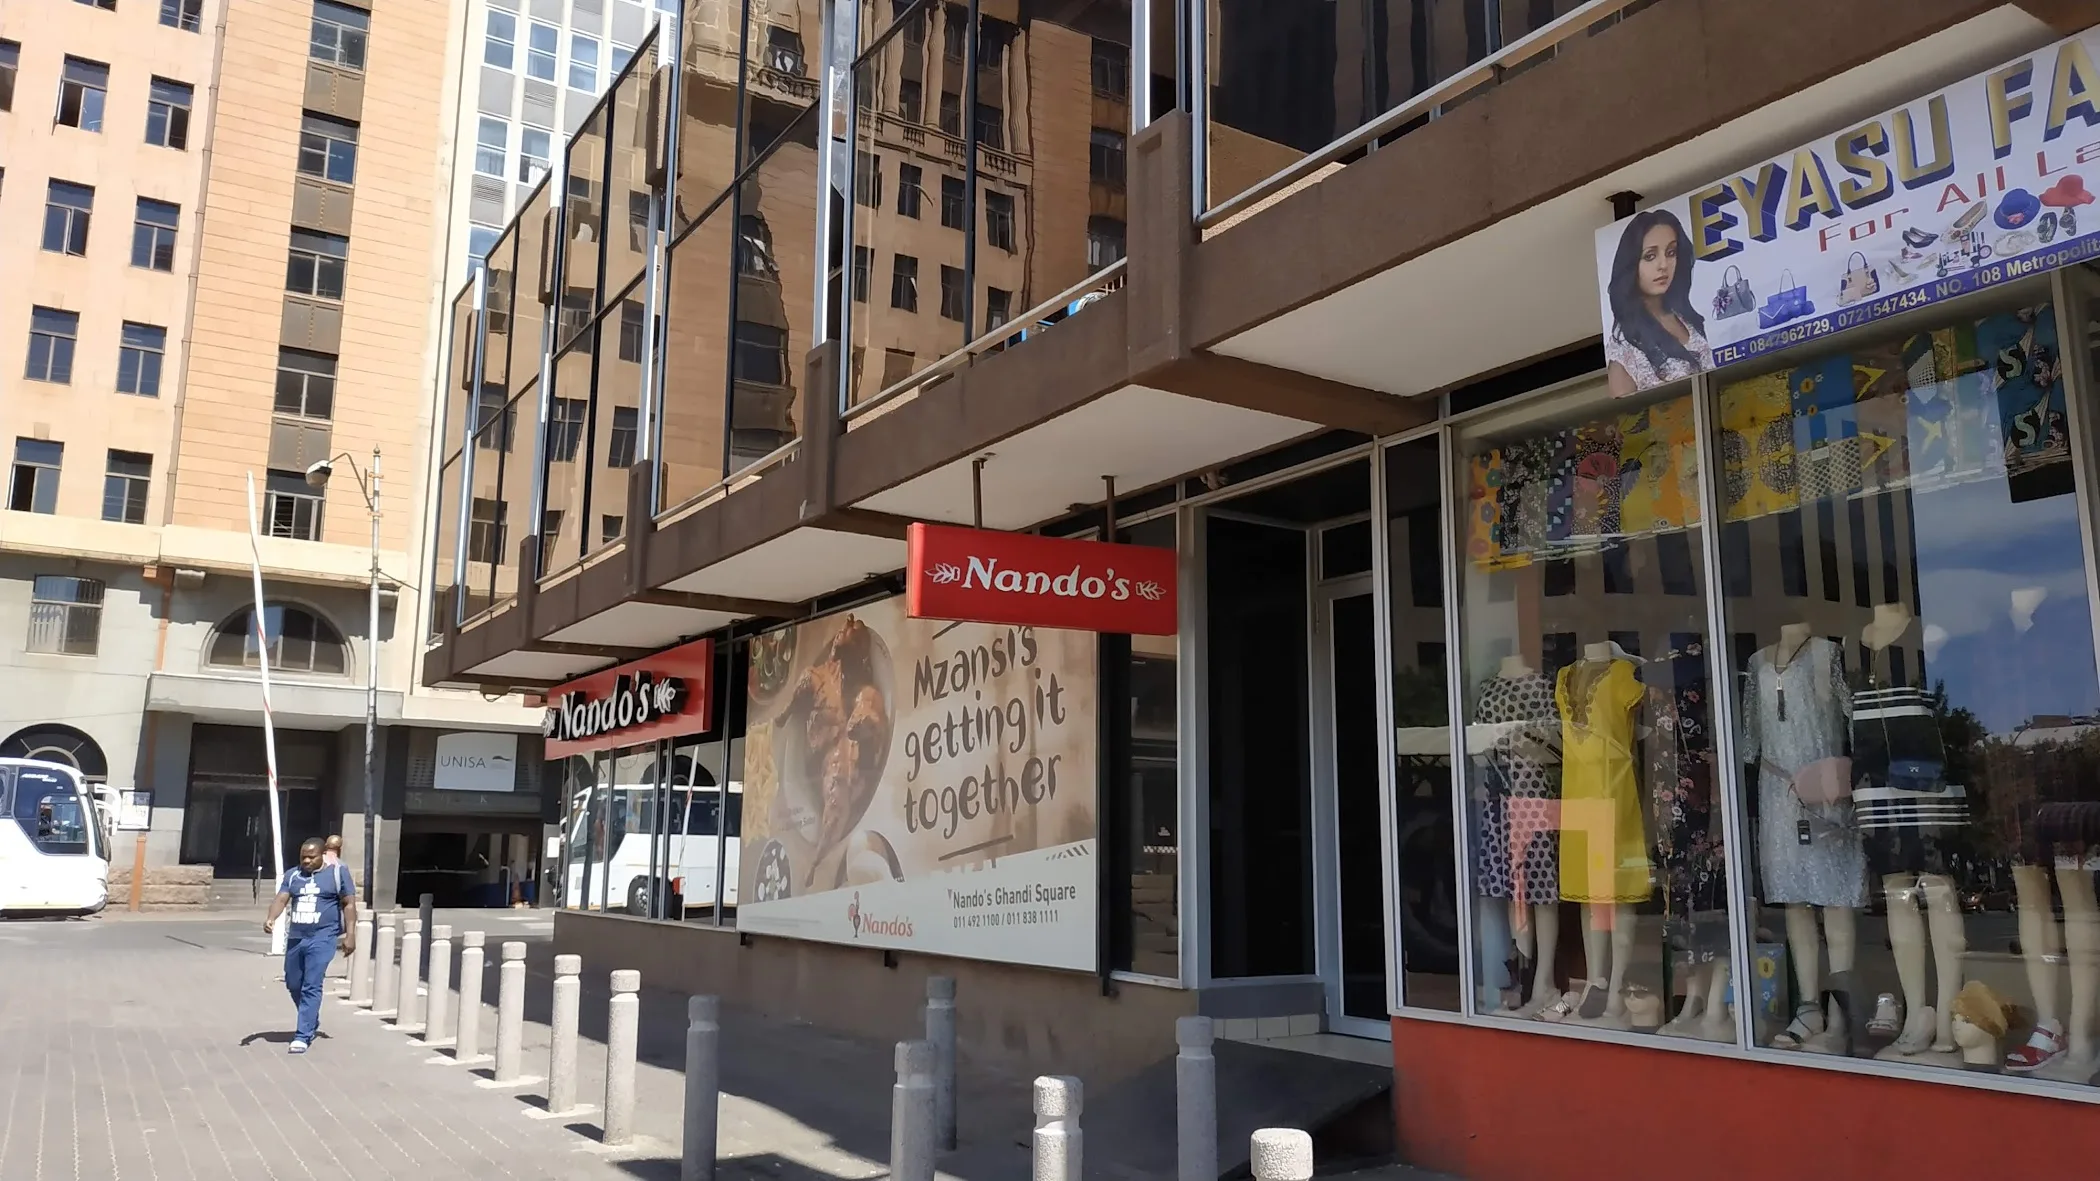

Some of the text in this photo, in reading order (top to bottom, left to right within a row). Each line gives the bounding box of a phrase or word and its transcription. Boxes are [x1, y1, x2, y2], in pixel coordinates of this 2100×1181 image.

[1688, 93, 1956, 262] EYASU
[1819, 207, 1909, 252] For
[1937, 165, 2006, 213] All
[1715, 346, 1746, 364] TEL:
[1973, 267, 2001, 287] 108
[2006, 239, 2100, 277] Metropolit
[961, 556, 1130, 601] Nando's
[557, 669, 651, 741] Nando's
[905, 667, 1066, 782] getting it
[440, 755, 487, 769] UNISA
[904, 754, 1062, 840] together
[862, 913, 914, 938] Nando's
[953, 883, 1077, 909] Nando's Ghandi Square
[953, 916, 966, 929] 011
[967, 914, 981, 928] 492
[983, 913, 1000, 927] 1100
[1006, 911, 1021, 926] 011
[1022, 910, 1037, 925] 838
[1040, 909, 1059, 924] 1111
